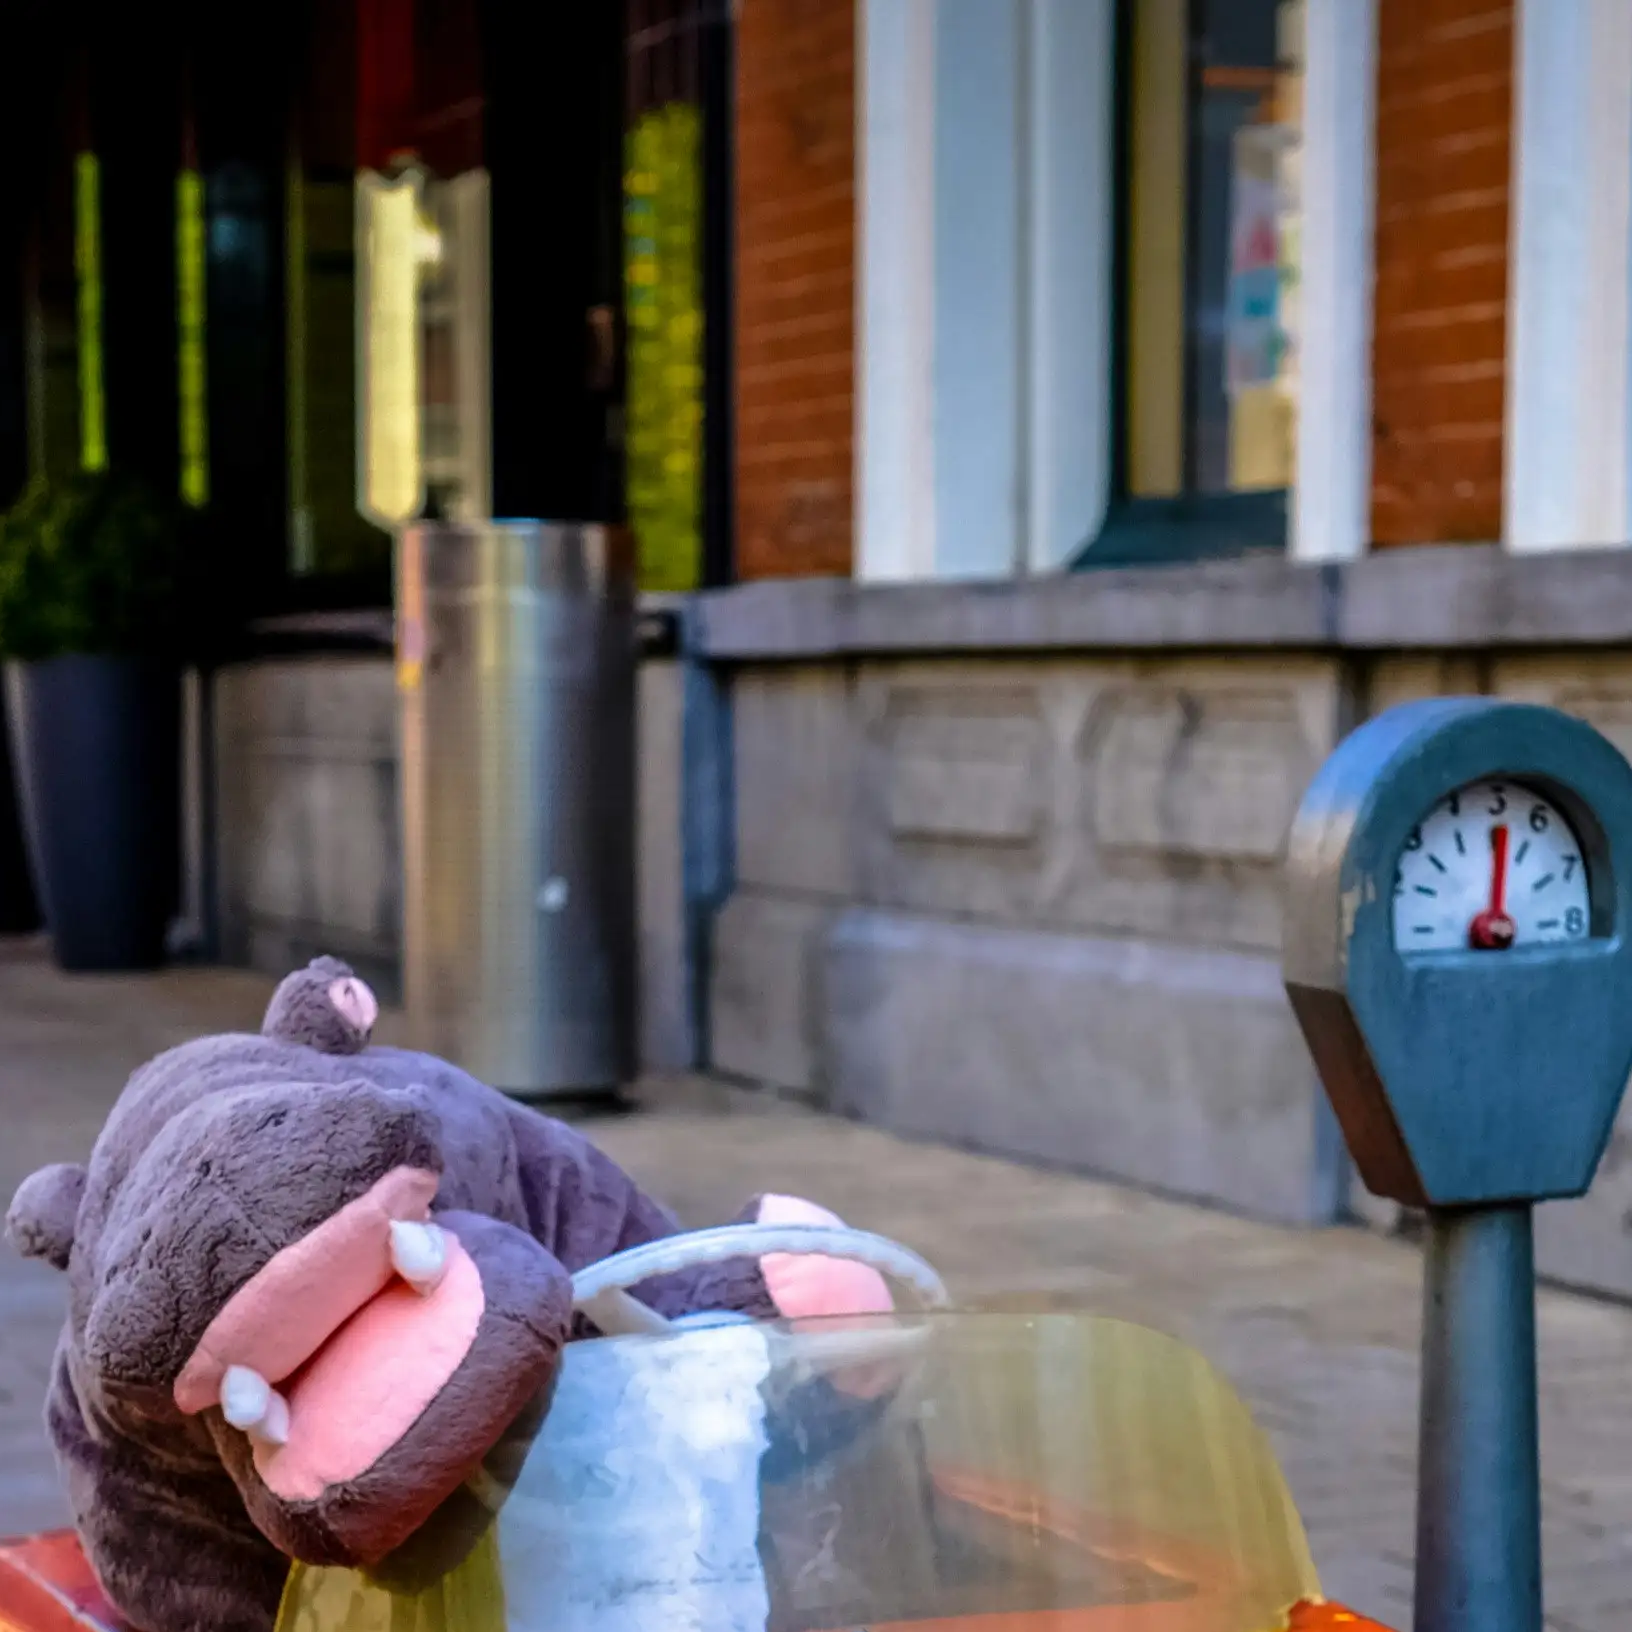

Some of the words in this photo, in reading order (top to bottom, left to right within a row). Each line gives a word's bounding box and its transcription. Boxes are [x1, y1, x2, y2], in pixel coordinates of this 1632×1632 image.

[1529, 804, 1549, 833] 6
[1561, 853, 1578, 883] 7
[1564, 905, 1584, 935] 8
